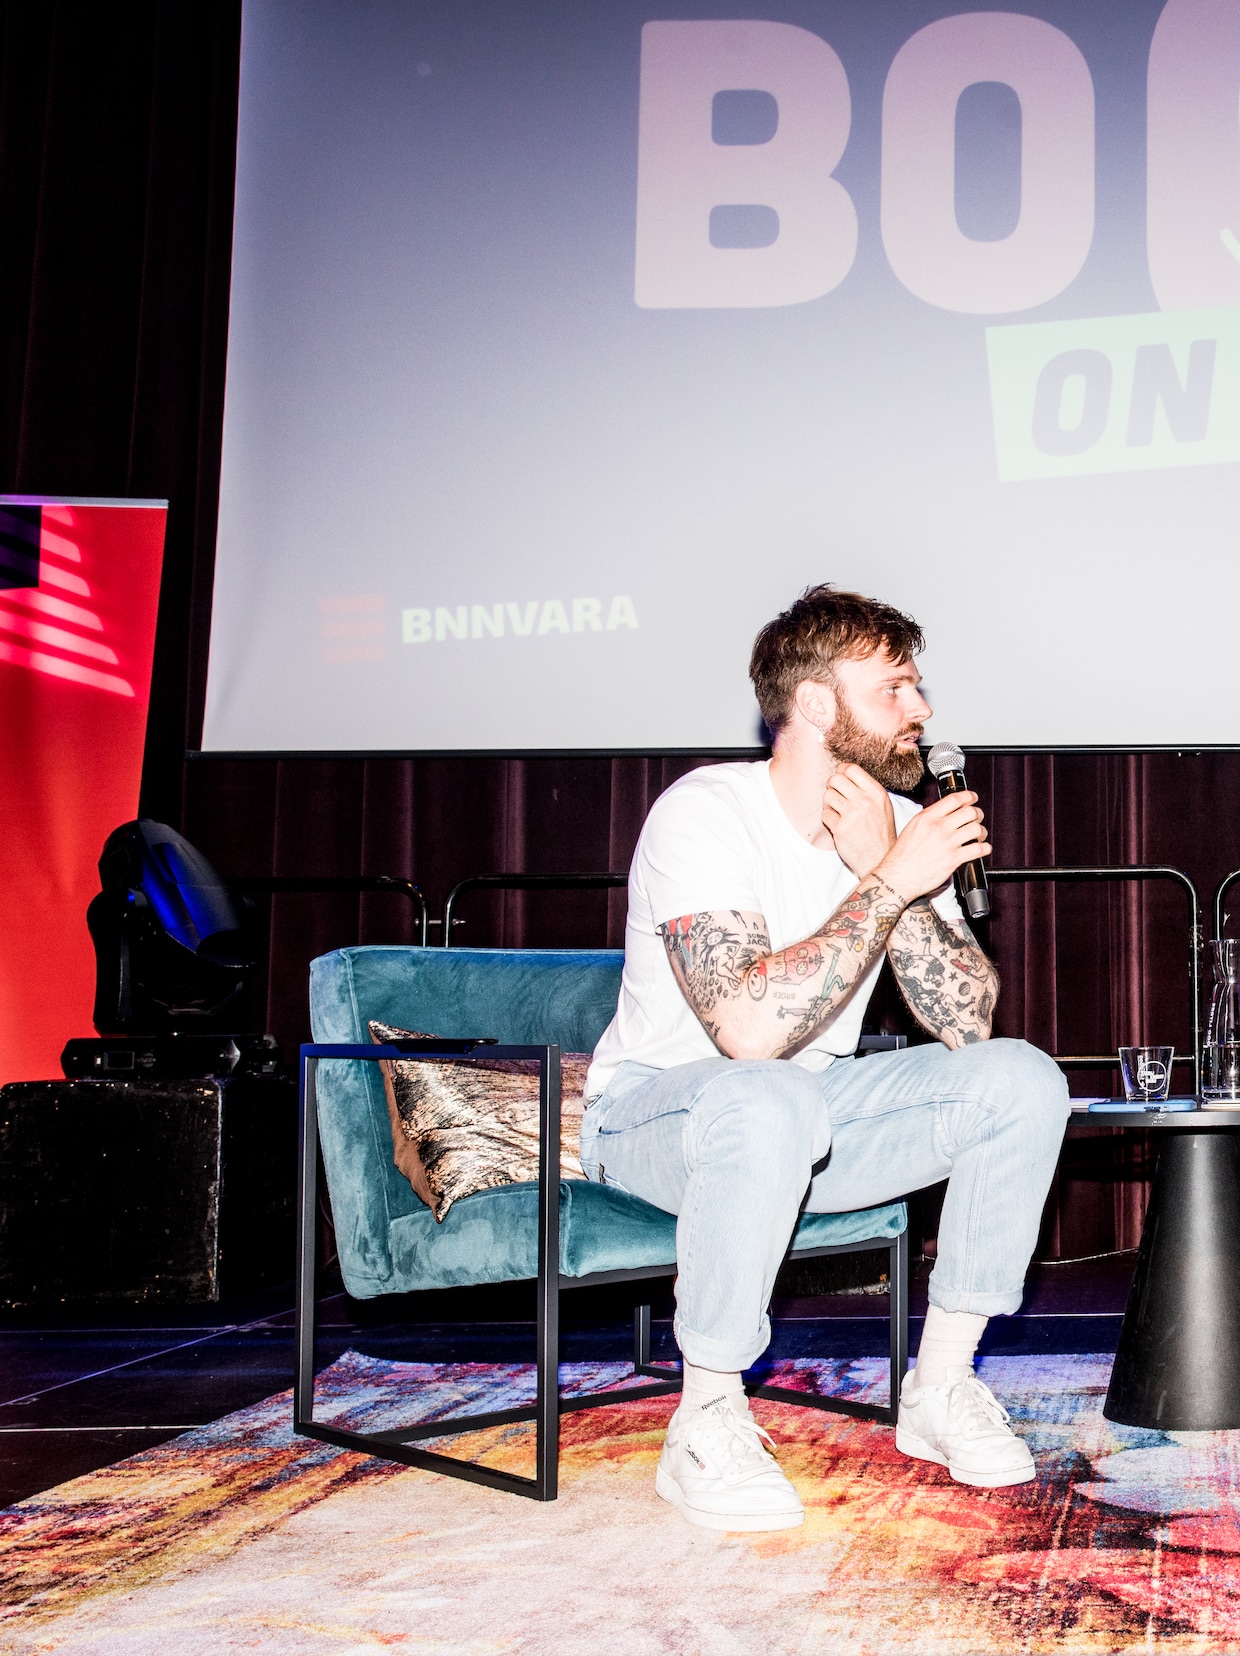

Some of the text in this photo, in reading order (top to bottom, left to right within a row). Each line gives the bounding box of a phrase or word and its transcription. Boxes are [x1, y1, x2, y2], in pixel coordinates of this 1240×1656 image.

[1030, 337, 1217, 459] ON
[402, 595, 640, 643] BNNVARA
[701, 1394, 727, 1411] Reebok
